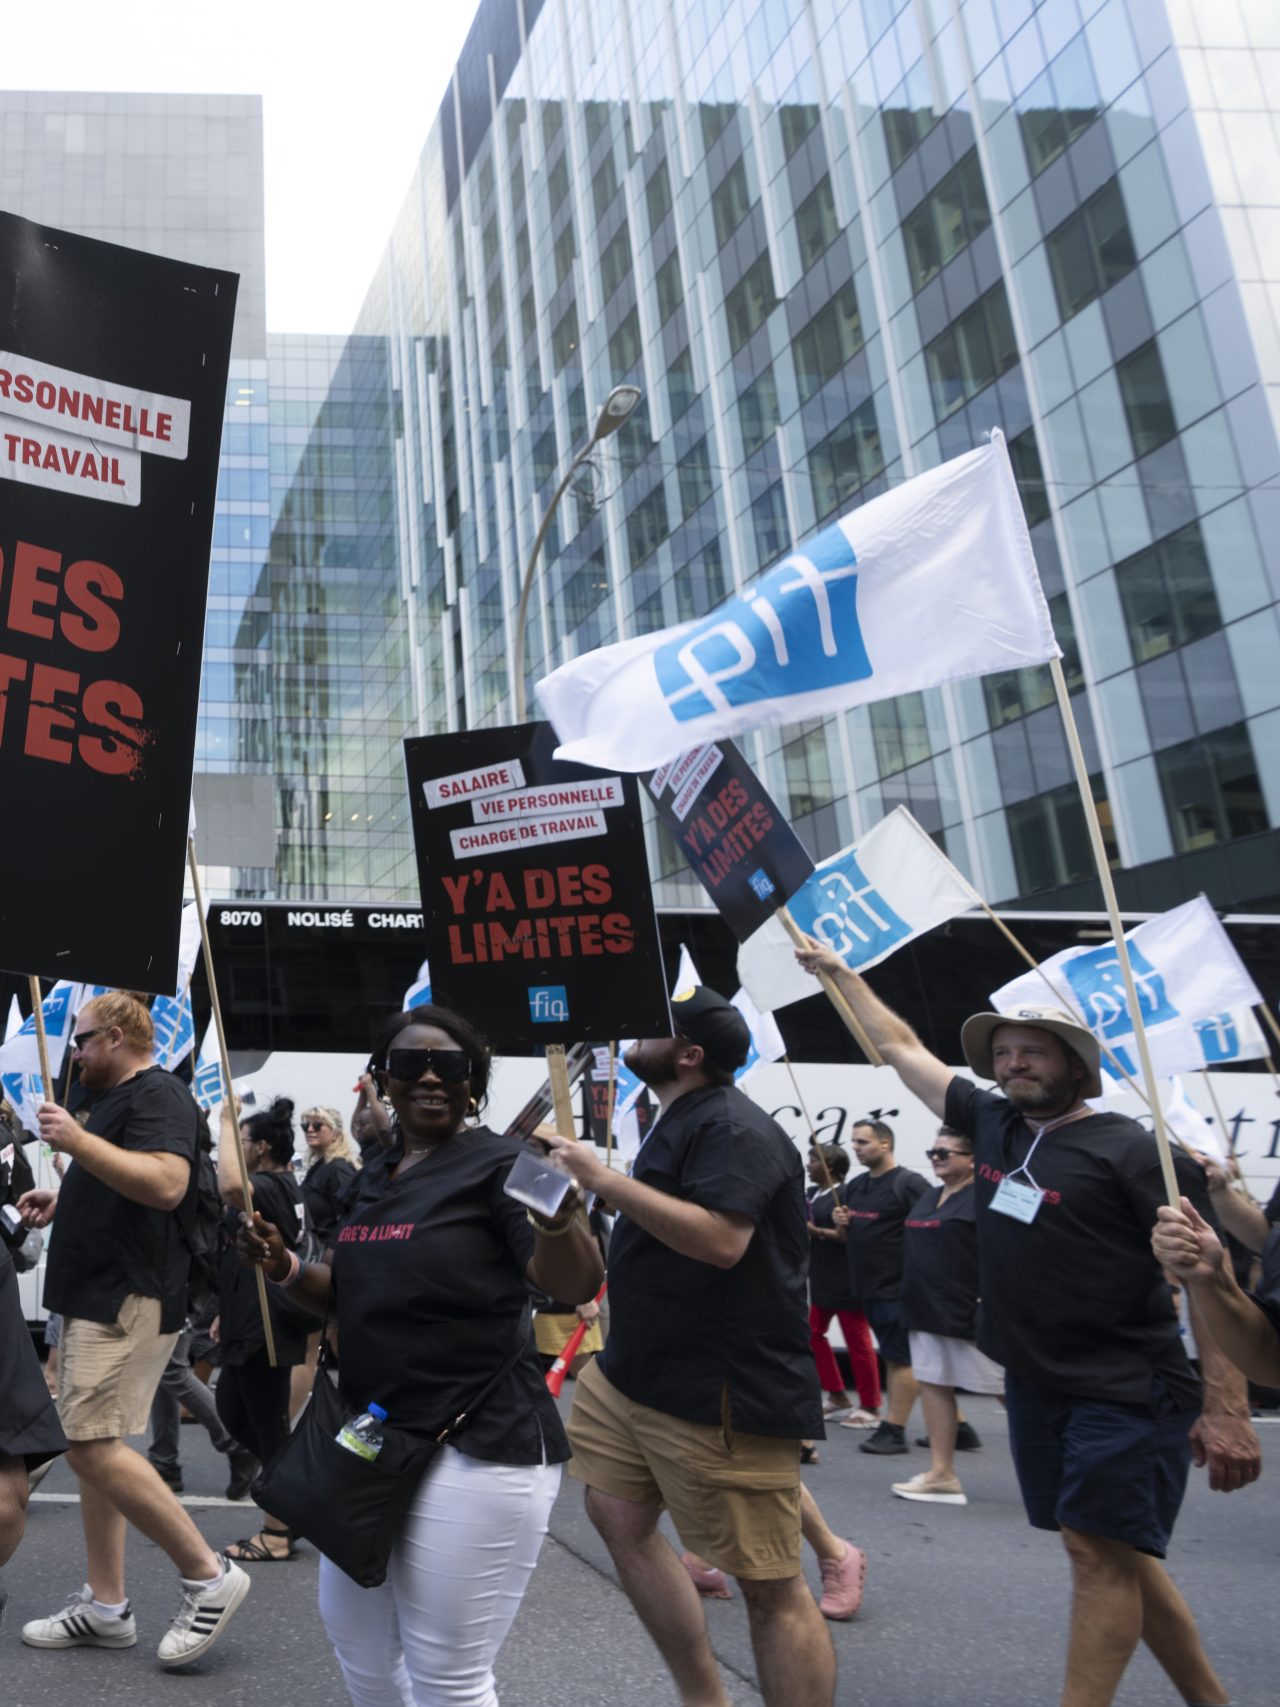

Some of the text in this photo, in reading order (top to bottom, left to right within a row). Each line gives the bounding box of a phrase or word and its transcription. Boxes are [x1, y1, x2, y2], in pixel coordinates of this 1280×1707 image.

[4, 434, 126, 487] TRAVAIL
[438, 769, 510, 799] SALAIRE
[480, 786, 615, 815] VIE PERSONNELLE
[706, 778, 749, 831] DES
[459, 815, 598, 850] CHARGE DE TRAVAIL
[702, 801, 774, 887] LIMITES
[441, 863, 613, 915] Y'A DES
[751, 877, 775, 900] fiq
[220, 911, 263, 927] 8070
[288, 909, 354, 928] NOLISÉ
[448, 912, 636, 965] LIMITES
[529, 991, 569, 1022] fiq
